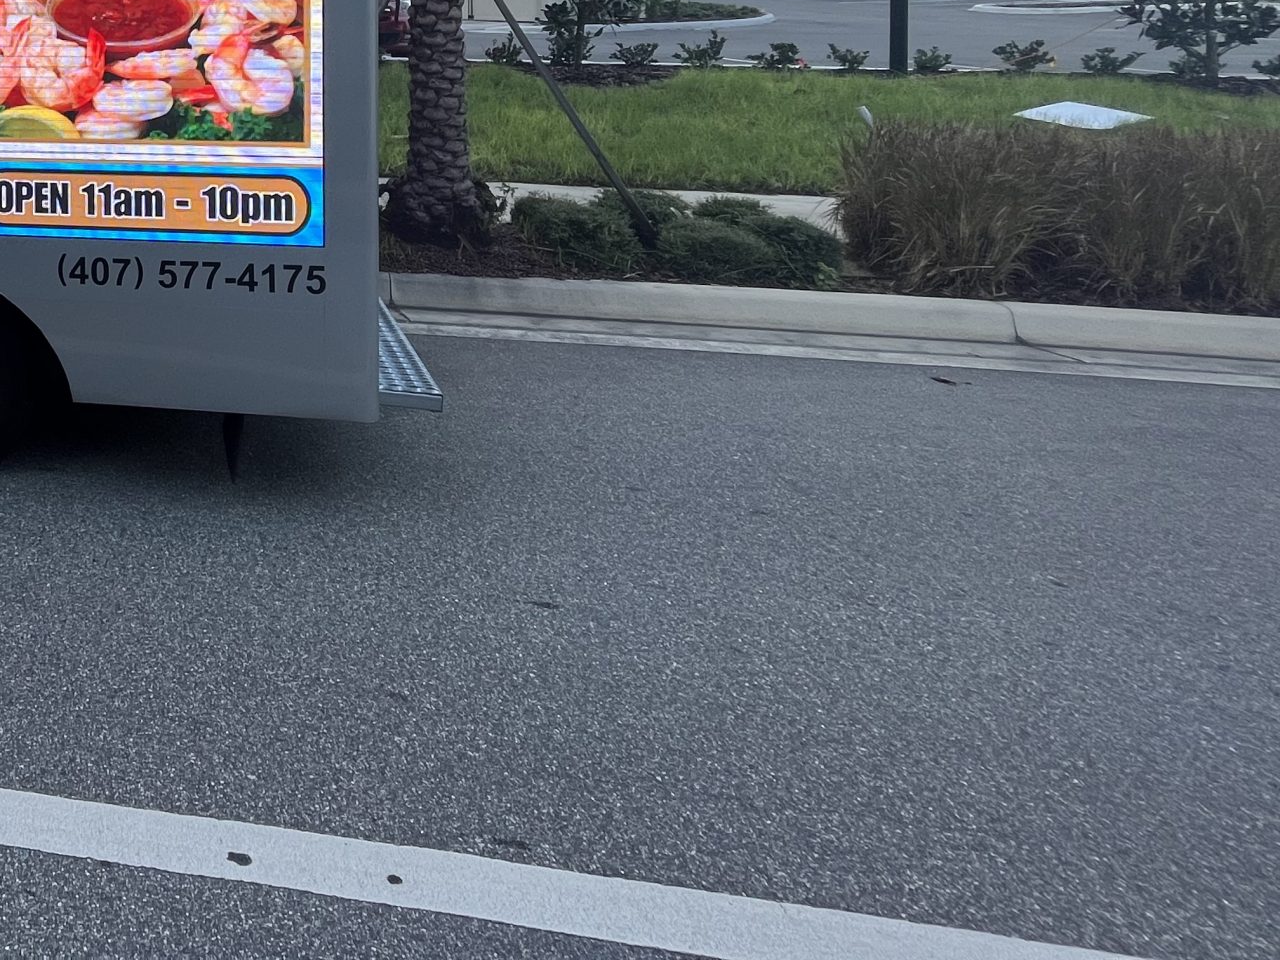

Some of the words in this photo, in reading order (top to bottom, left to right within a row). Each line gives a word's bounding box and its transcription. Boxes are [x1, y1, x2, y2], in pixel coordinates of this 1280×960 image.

[81, 182, 165, 218] 11am
[201, 185, 295, 223] 10pm
[57, 253, 145, 290] (407)
[158, 260, 327, 296] 577-4175
